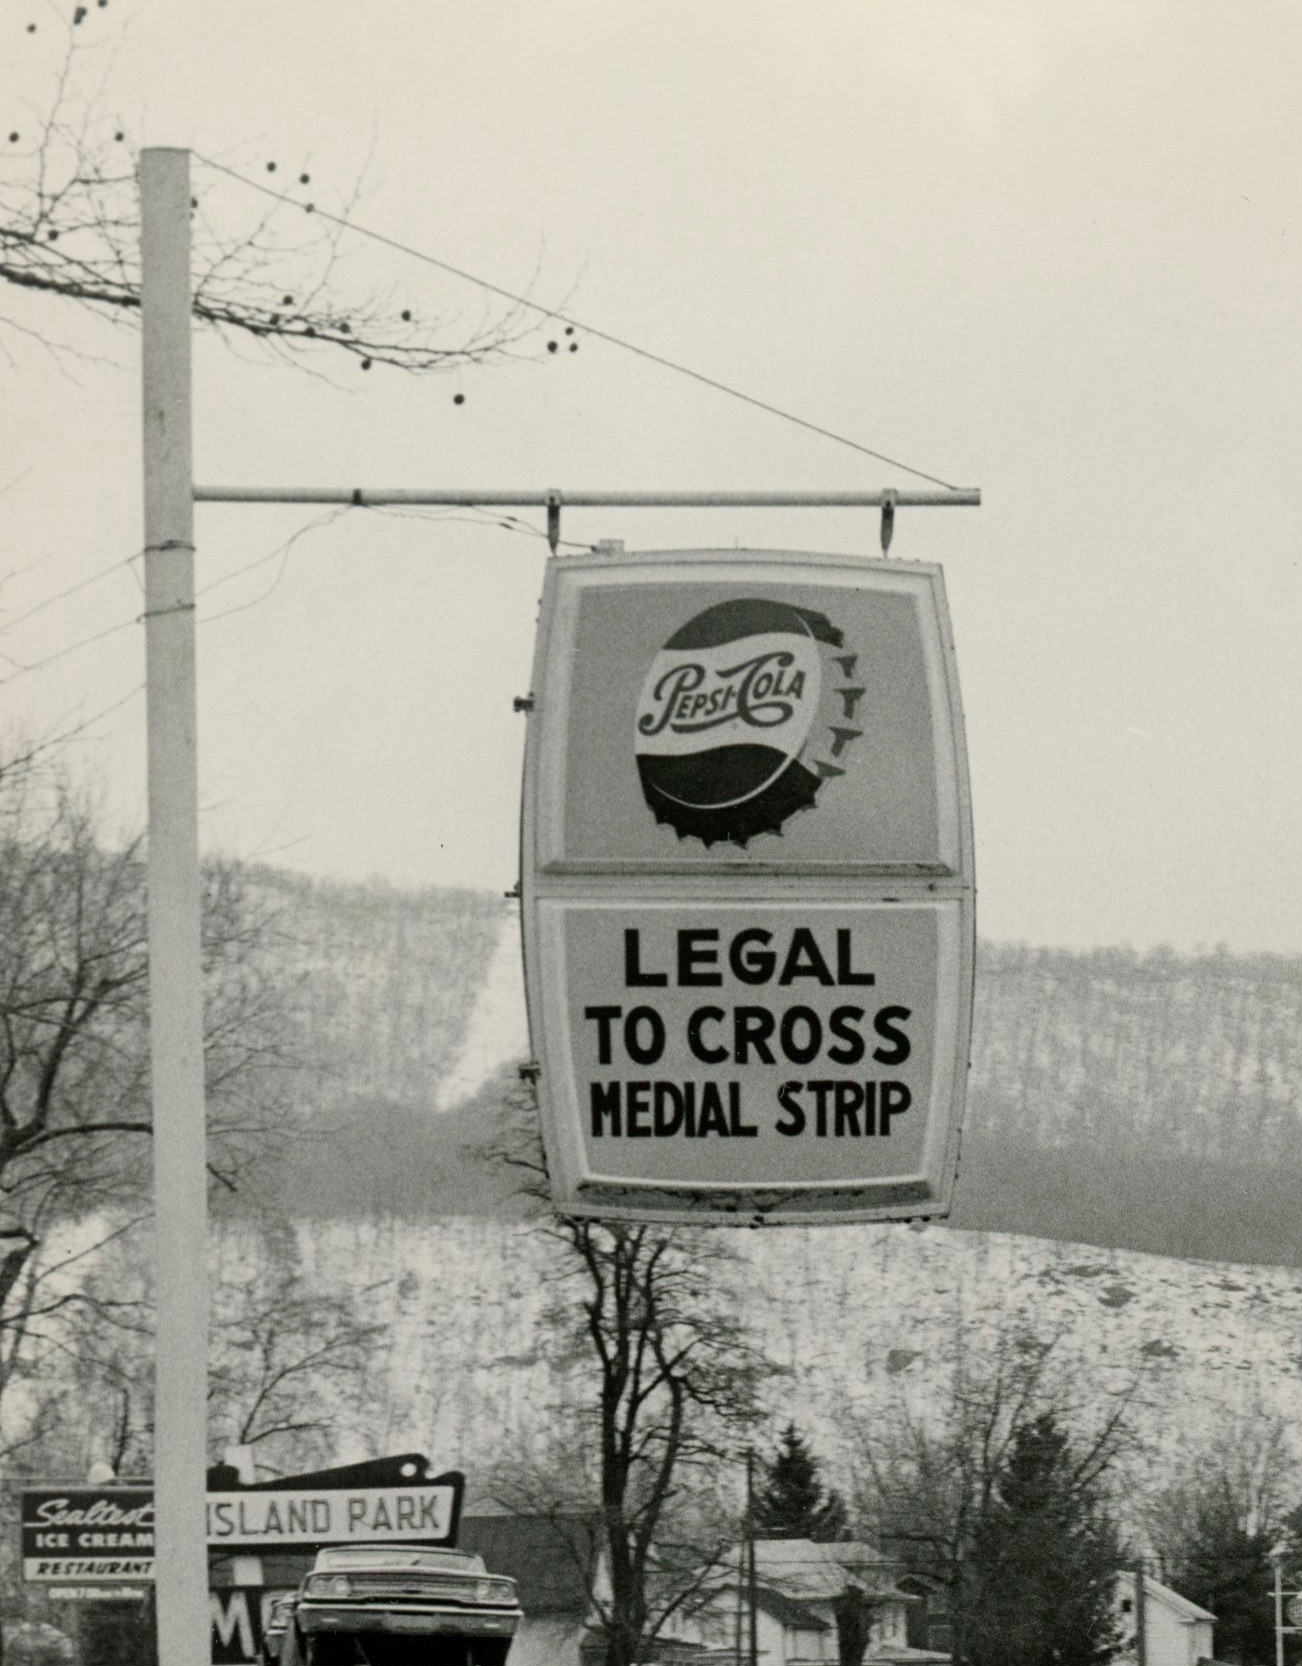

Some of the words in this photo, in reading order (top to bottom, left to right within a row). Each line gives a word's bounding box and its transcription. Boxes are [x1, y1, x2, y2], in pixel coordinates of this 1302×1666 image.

[624, 928, 875, 987] LEGAL
[585, 1005, 665, 1065] TO
[687, 1005, 912, 1066] CROSS
[591, 1081, 758, 1137] MEDIAL
[775, 1080, 912, 1137] STRIP
[24, 1498, 155, 1527] Sealtest
[206, 1499, 330, 1536] ISLAND
[348, 1495, 440, 1532] PARK
[36, 1533, 70, 1547] ICE
[78, 1533, 154, 1547] CREAM
[36, 1562, 153, 1575] RESTAURANT
